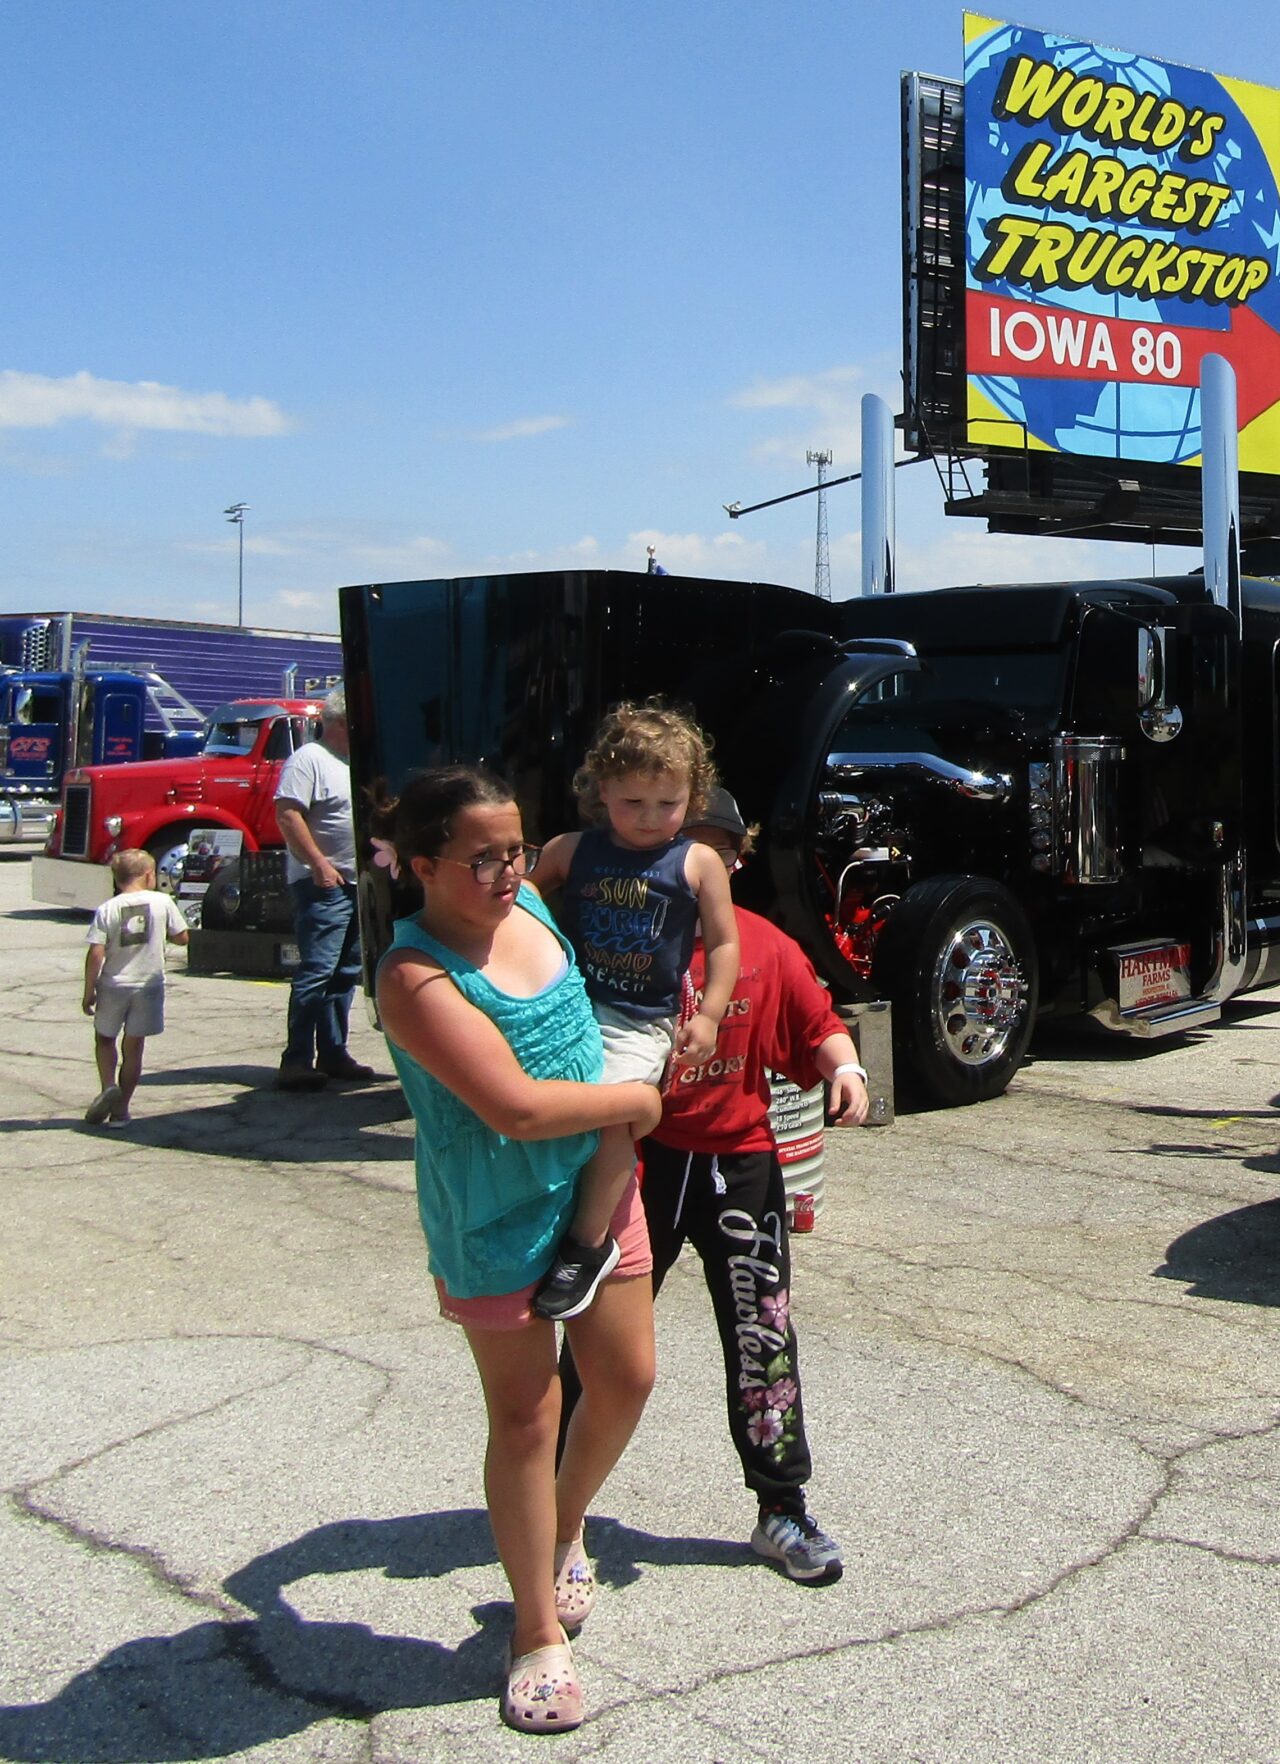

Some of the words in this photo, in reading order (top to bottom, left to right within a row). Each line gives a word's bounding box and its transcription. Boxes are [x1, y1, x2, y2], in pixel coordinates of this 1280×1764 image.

[1001, 55, 1225, 160] WORLD'S
[1009, 140, 1231, 231] LARGEST
[979, 217, 1270, 305] TRUCKSTOP
[990, 307, 1118, 372] IOWA
[1131, 327, 1182, 379] 80
[596, 877, 649, 910] SUN
[584, 941, 653, 973] SAND
[1142, 969, 1171, 987] FARMS
[680, 1055, 747, 1084] GLORY
[718, 1209, 786, 1390] Flawless
